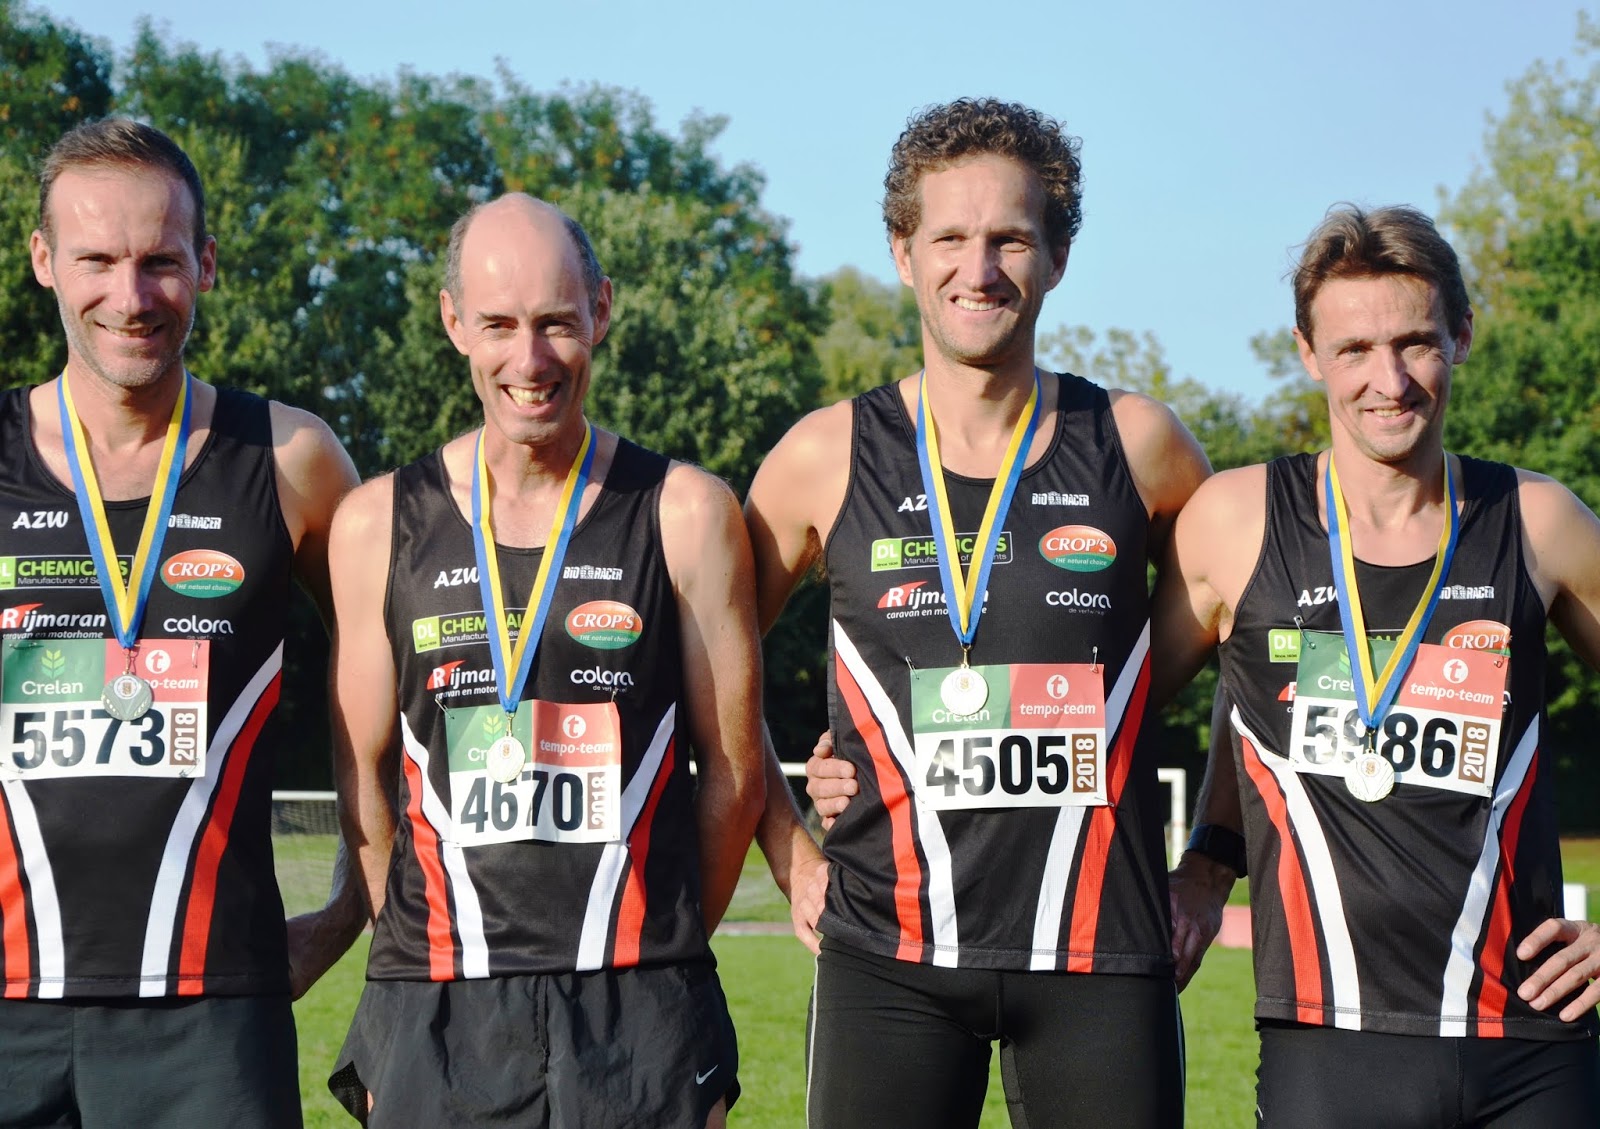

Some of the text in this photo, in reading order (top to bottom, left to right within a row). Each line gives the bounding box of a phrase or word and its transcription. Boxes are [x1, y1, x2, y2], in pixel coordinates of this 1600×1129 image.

[898, 494, 928, 512] AZ
[12, 511, 69, 529] AZW
[877, 544, 899, 559] DL
[1046, 538, 1109, 553] CROP'S
[18, 560, 128, 576] CHEMICS
[904, 556, 939, 565] Manufac
[168, 562, 234, 577] CROP'S
[18, 577, 76, 585] Manufacturer
[79, 576, 88, 584] of
[1045, 588, 1111, 609] colora
[2, 608, 106, 632] Rijmaran
[572, 613, 635, 629] CROP'S
[886, 610, 919, 619] caravan
[163, 615, 233, 634] colora
[417, 623, 436, 639] DL
[48, 630, 103, 638] motorhome
[1273, 635, 1297, 650] DL
[570, 665, 634, 686] colora
[22, 680, 83, 695] Crelan
[474, 686, 498, 695] motor
[1410, 683, 1494, 704] tempo-team
[1020, 703, 1096, 719] tempo-team
[12, 709, 165, 769] 5573
[174, 712, 196, 761] 2018
[1302, 704, 1457, 778] 5986
[539, 739, 614, 756] tempo-team
[1462, 727, 1488, 779] 2018
[926, 735, 1069, 796] 4505
[1076, 738, 1095, 789] 2018
[461, 770, 583, 833] 4670
